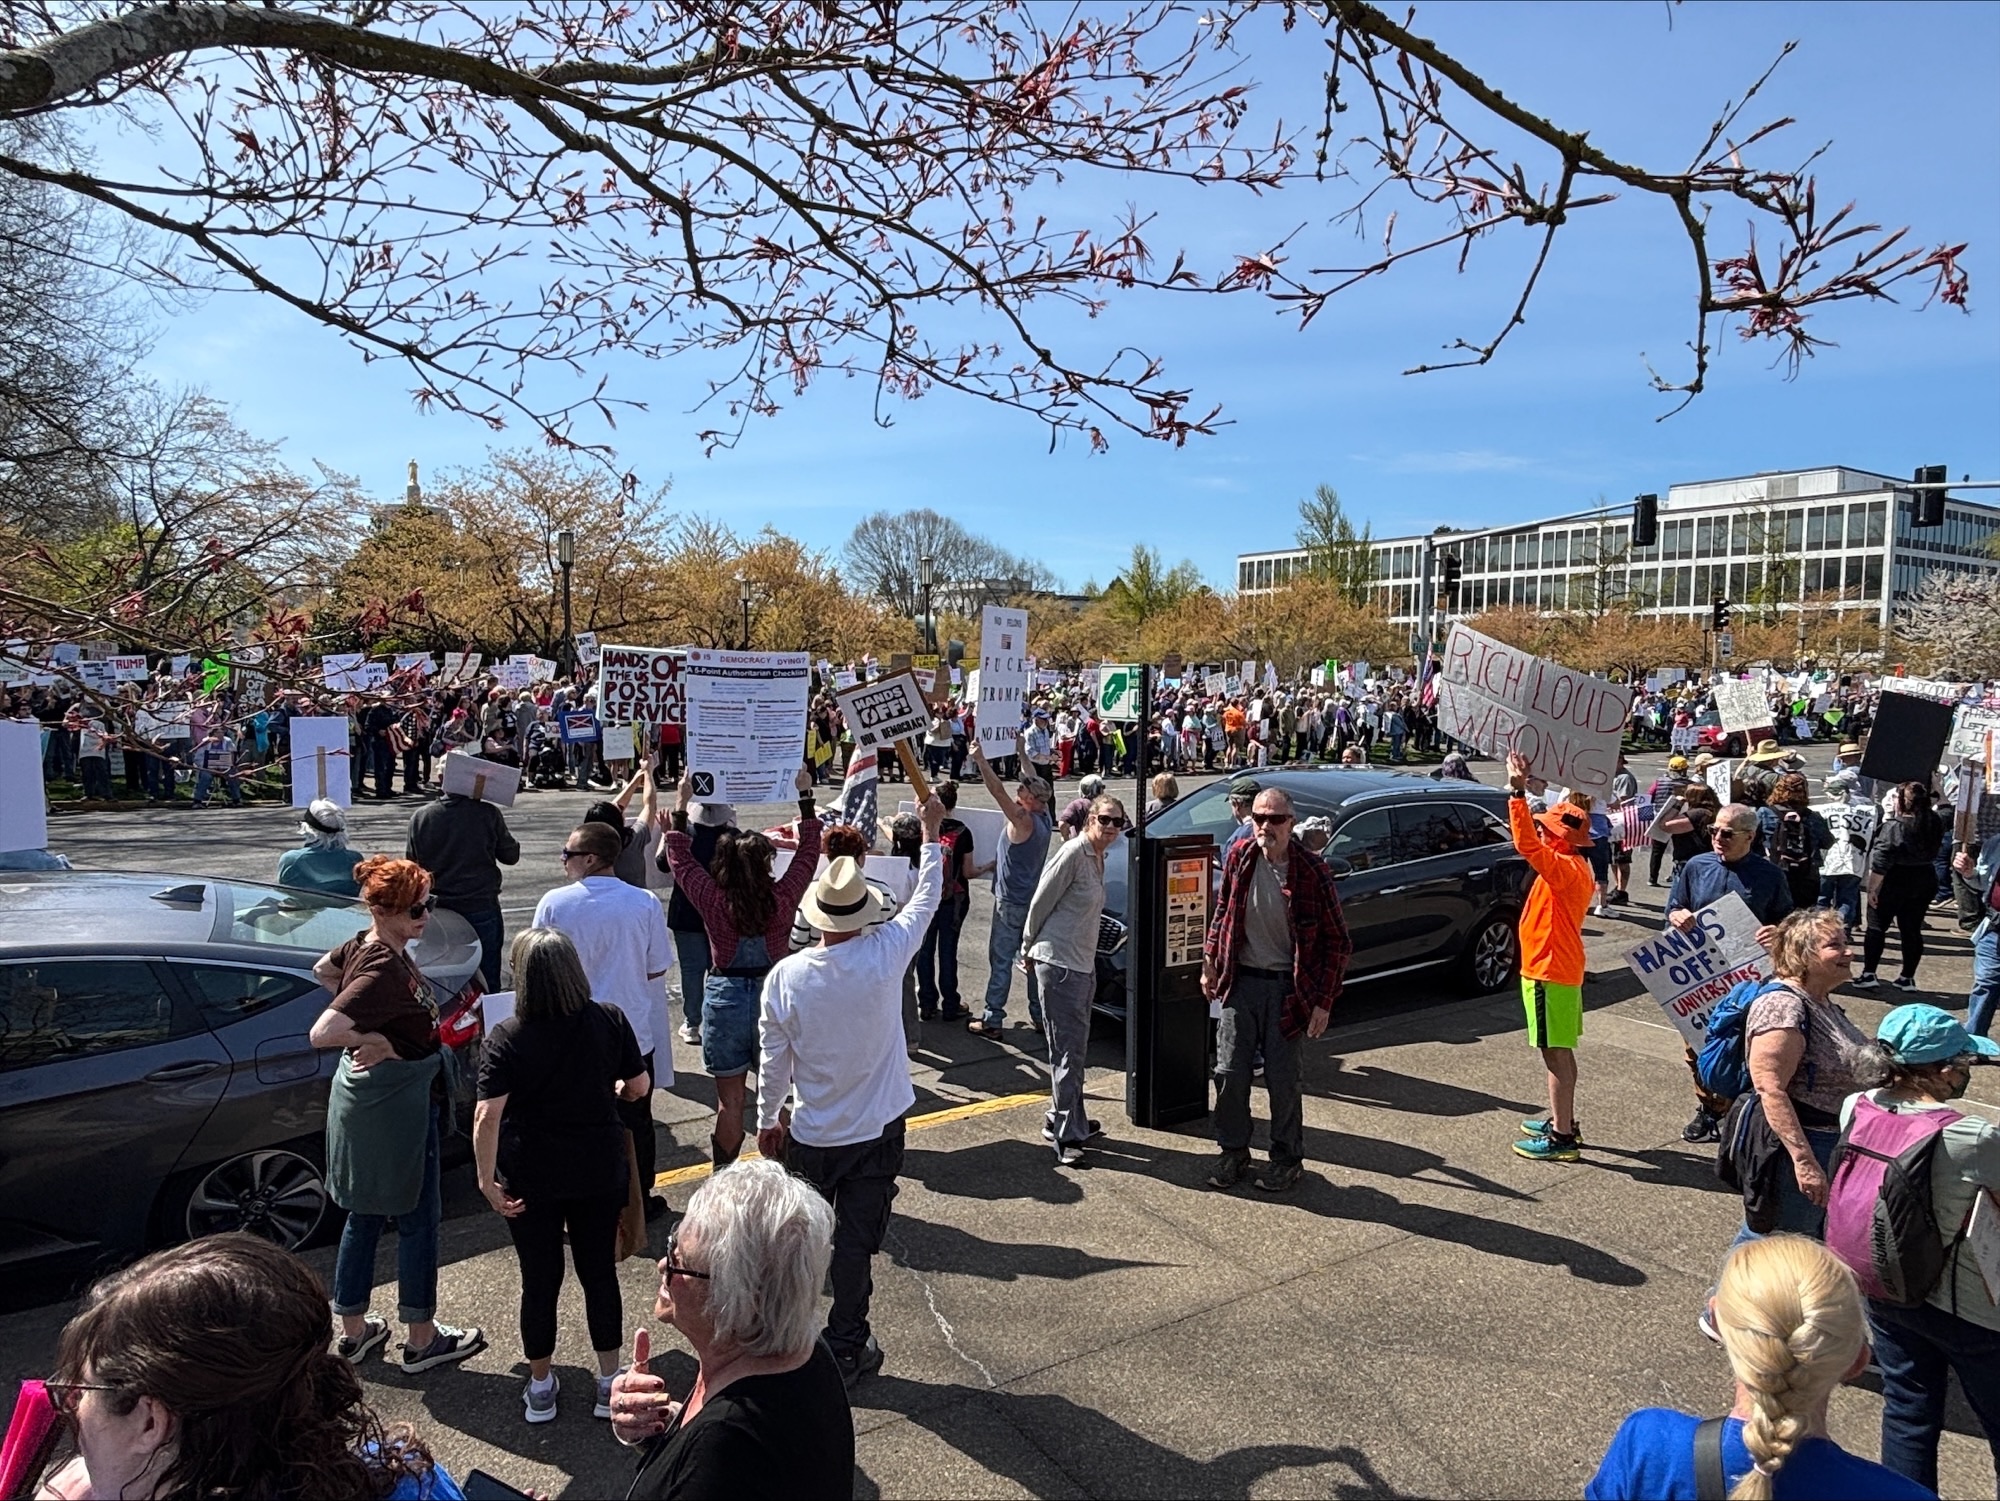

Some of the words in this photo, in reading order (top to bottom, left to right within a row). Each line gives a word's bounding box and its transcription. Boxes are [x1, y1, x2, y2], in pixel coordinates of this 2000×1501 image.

[602, 650, 650, 669] HANDS
[651, 655, 687, 682] OF
[777, 657, 806, 665] DYING?
[985, 656, 1024, 672] FUCK
[606, 670, 632, 681] THE
[634, 671, 650, 684] US
[722, 669, 771, 677] Authoritarian
[772, 669, 807, 677] Checklist
[1449, 631, 1524, 702] RICH
[1532, 665, 1627, 733] LOUD
[245, 680, 267, 690] OFF
[604, 681, 687, 703] POSTAL
[983, 687, 1020, 702] TRUMP
[238, 694, 266, 707] SSA
[854, 686, 904, 712] HANDS
[605, 702, 687, 722] SERVICE
[860, 699, 911, 728] OFF!
[860, 732, 877, 747] OUR
[881, 715, 927, 739] DEMOCRACY
[981, 727, 992, 741] NO
[995, 726, 1019, 741] KINGS
[1448, 684, 1607, 785] WRONG
[1828, 813, 1873, 834] ESS!
[1632, 908, 1726, 974] HANDS
[1672, 962, 1762, 1017] UNIVERSITIES
[1874, 1217, 1888, 1265] SUMMIT
